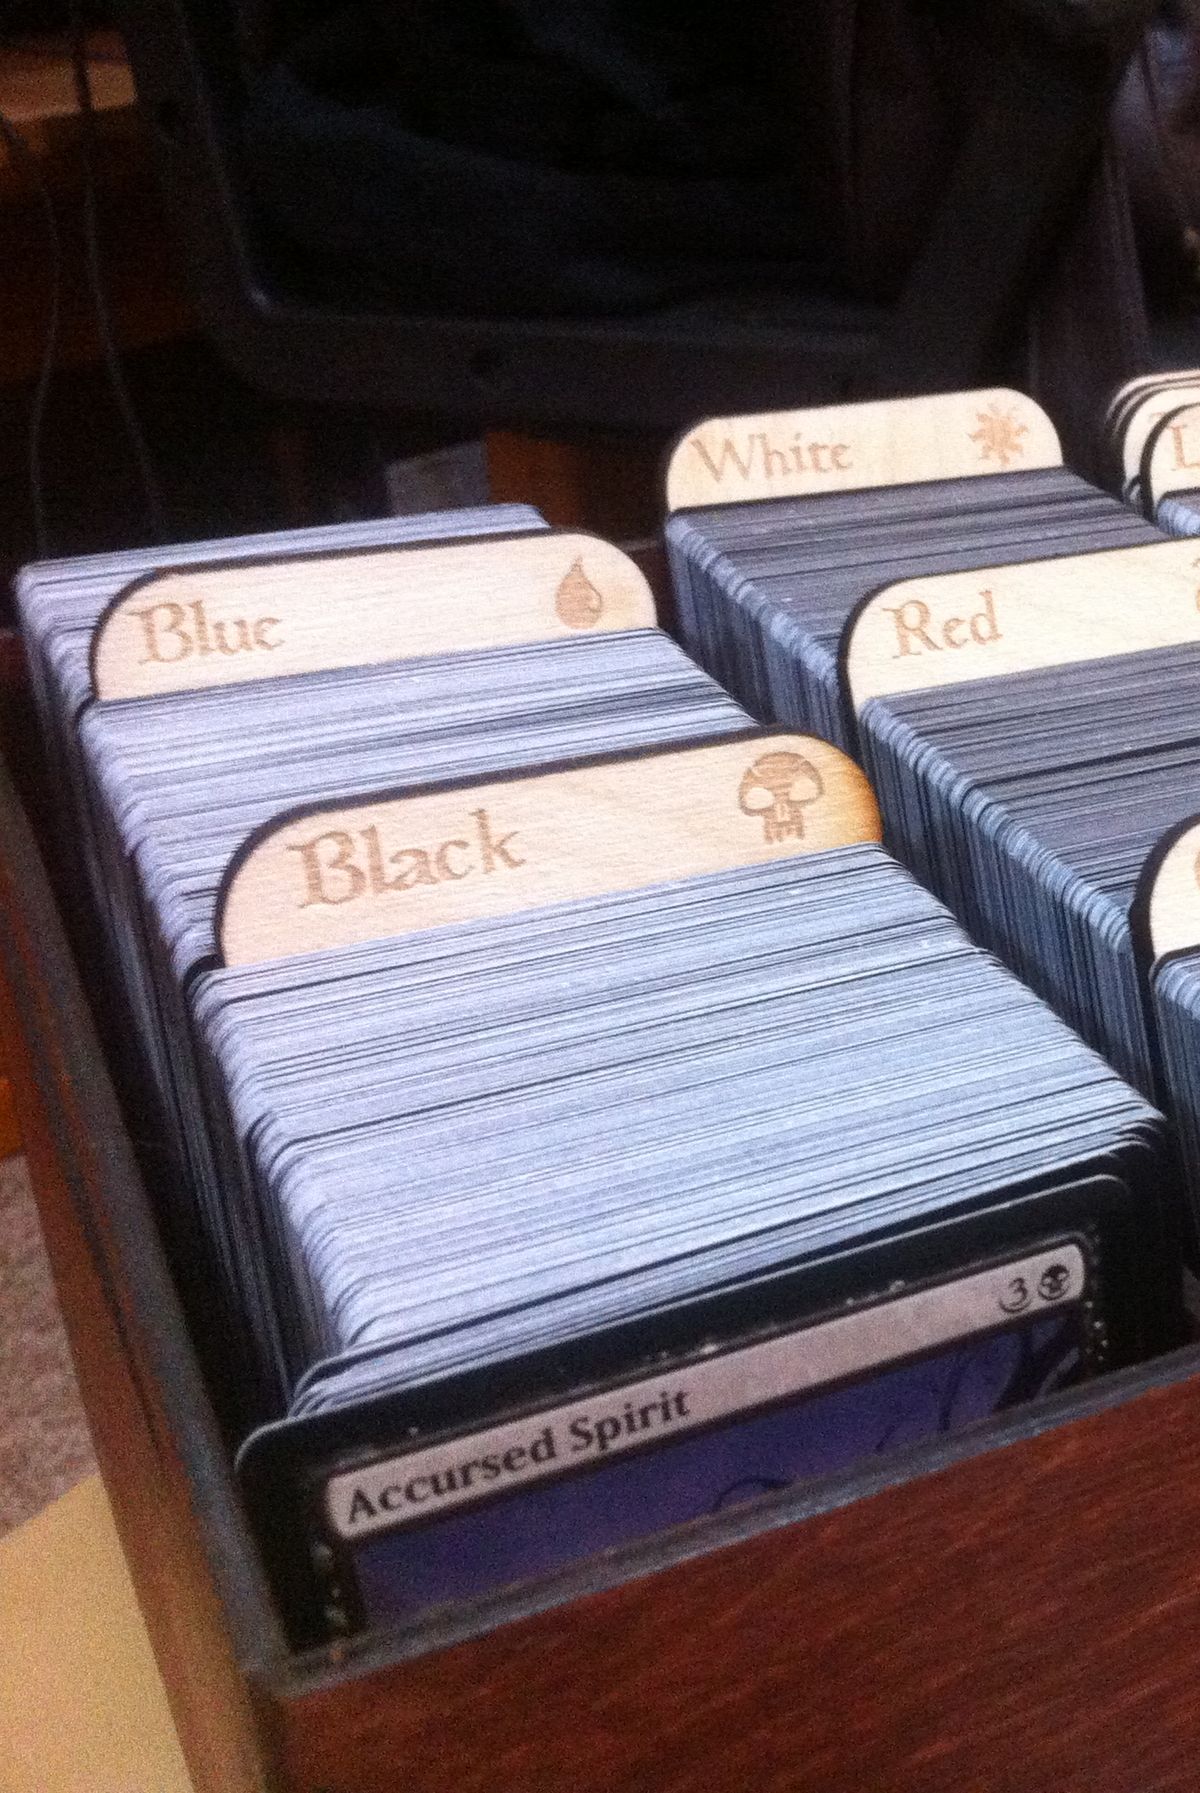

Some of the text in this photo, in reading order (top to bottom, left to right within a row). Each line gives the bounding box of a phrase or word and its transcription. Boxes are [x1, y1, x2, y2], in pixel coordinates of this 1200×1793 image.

[690, 432, 853, 484] White
[127, 600, 285, 665] Blue
[882, 589, 1003, 659] Red
[286, 808, 526, 908] Black
[350, 1390, 691, 1523] Accursed Spirit
